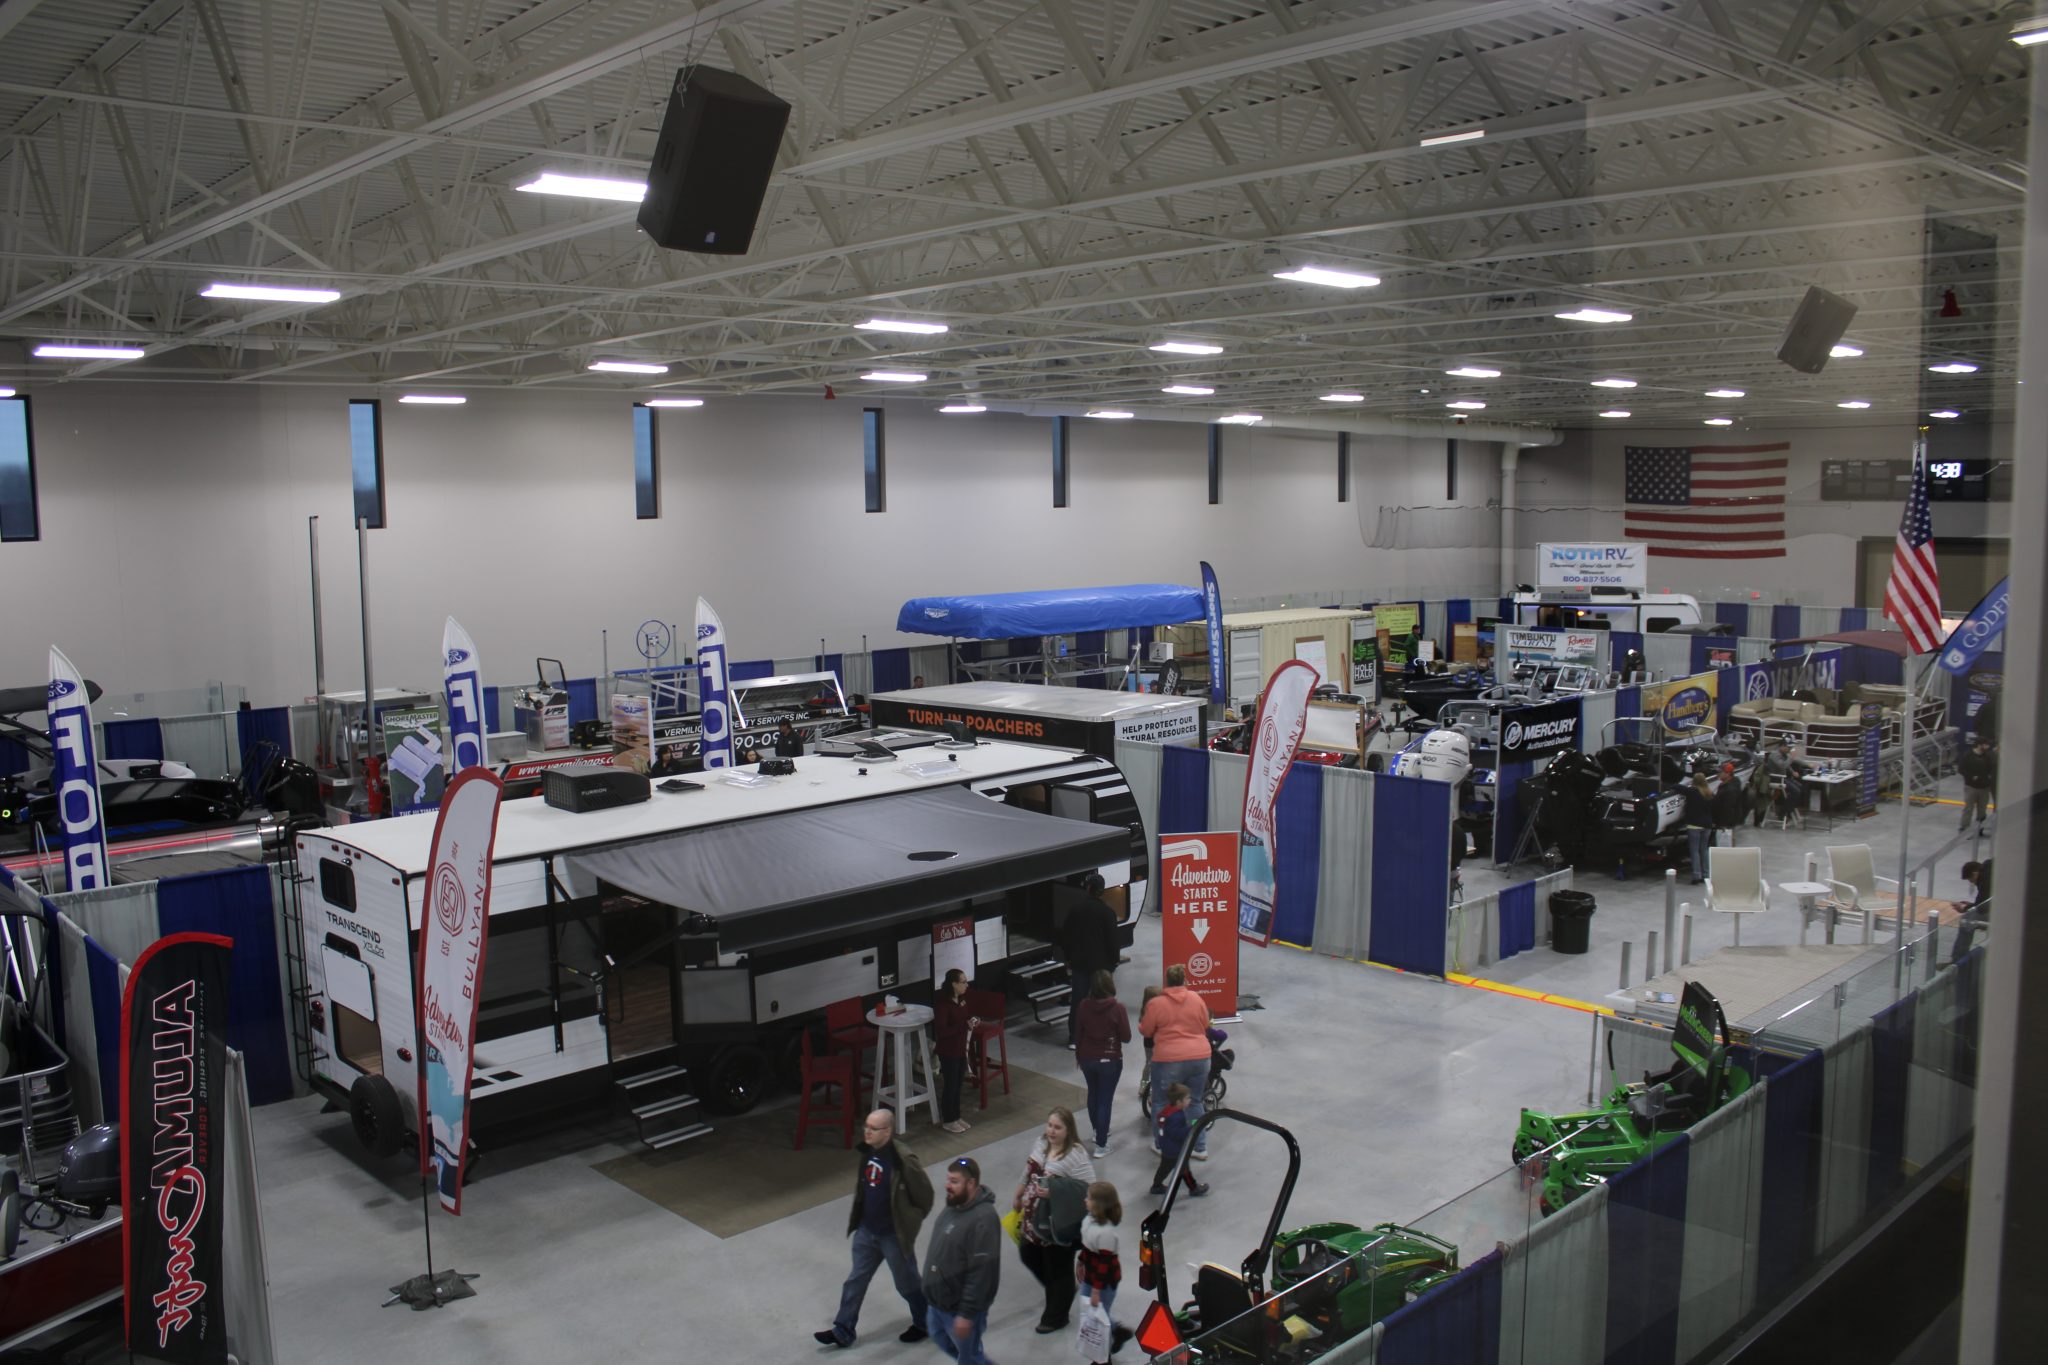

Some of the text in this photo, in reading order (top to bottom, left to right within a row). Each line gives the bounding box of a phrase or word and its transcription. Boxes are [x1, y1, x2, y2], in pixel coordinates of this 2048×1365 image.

[1930, 462, 1962, 478] 4:38
[1605, 547, 1627, 560] RV
[1510, 632, 1557, 642] TIMBUKTU
[1354, 663, 1373, 671] HOLE
[907, 708, 944, 726] TURN
[966, 714, 1045, 738] POACHERS
[1122, 716, 1194, 735] HELP PROTECT OUR
[1523, 718, 1577, 741] MERCURY
[1157, 724, 1197, 739] RESOURCES
[1527, 735, 1572, 751] Authorized Dealer
[1170, 862, 1232, 888] Adventure
[1183, 886, 1219, 900] STARTS
[1173, 900, 1228, 915] HERE
[325, 910, 381, 944] TRANSCEND
[462, 884, 485, 999] BULLYAN
